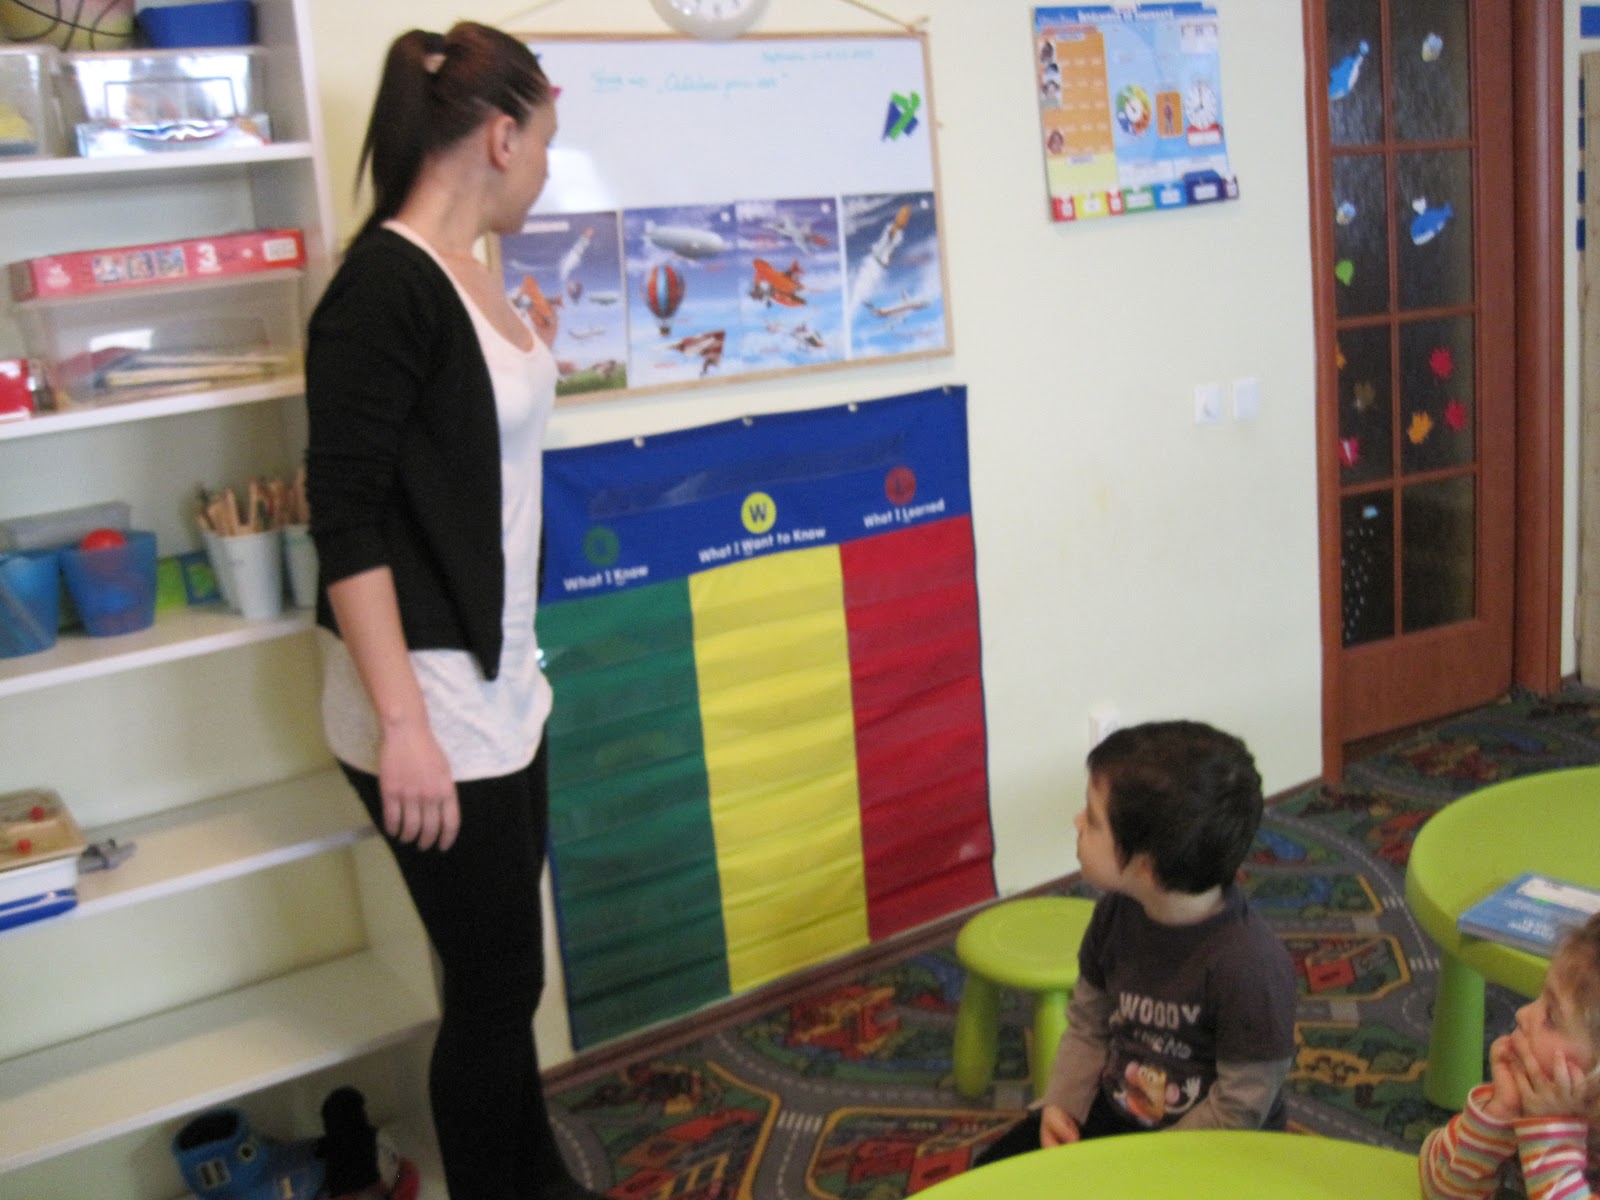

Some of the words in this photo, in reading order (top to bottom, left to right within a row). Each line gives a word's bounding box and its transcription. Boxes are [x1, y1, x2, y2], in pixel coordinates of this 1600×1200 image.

[197, 242, 218, 267] 3
[749, 502, 768, 523] W
[863, 510, 892, 529] What
[895, 507, 901, 523] I
[902, 496, 945, 524] Learned
[699, 543, 732, 563] What
[734, 541, 740, 555] I
[742, 534, 774, 556] Want
[776, 532, 791, 545] to
[792, 527, 826, 542] Know
[563, 572, 603, 591] What
[605, 569, 612, 585] I
[613, 565, 649, 586] Know
[1119, 991, 1202, 1030] WOODY
